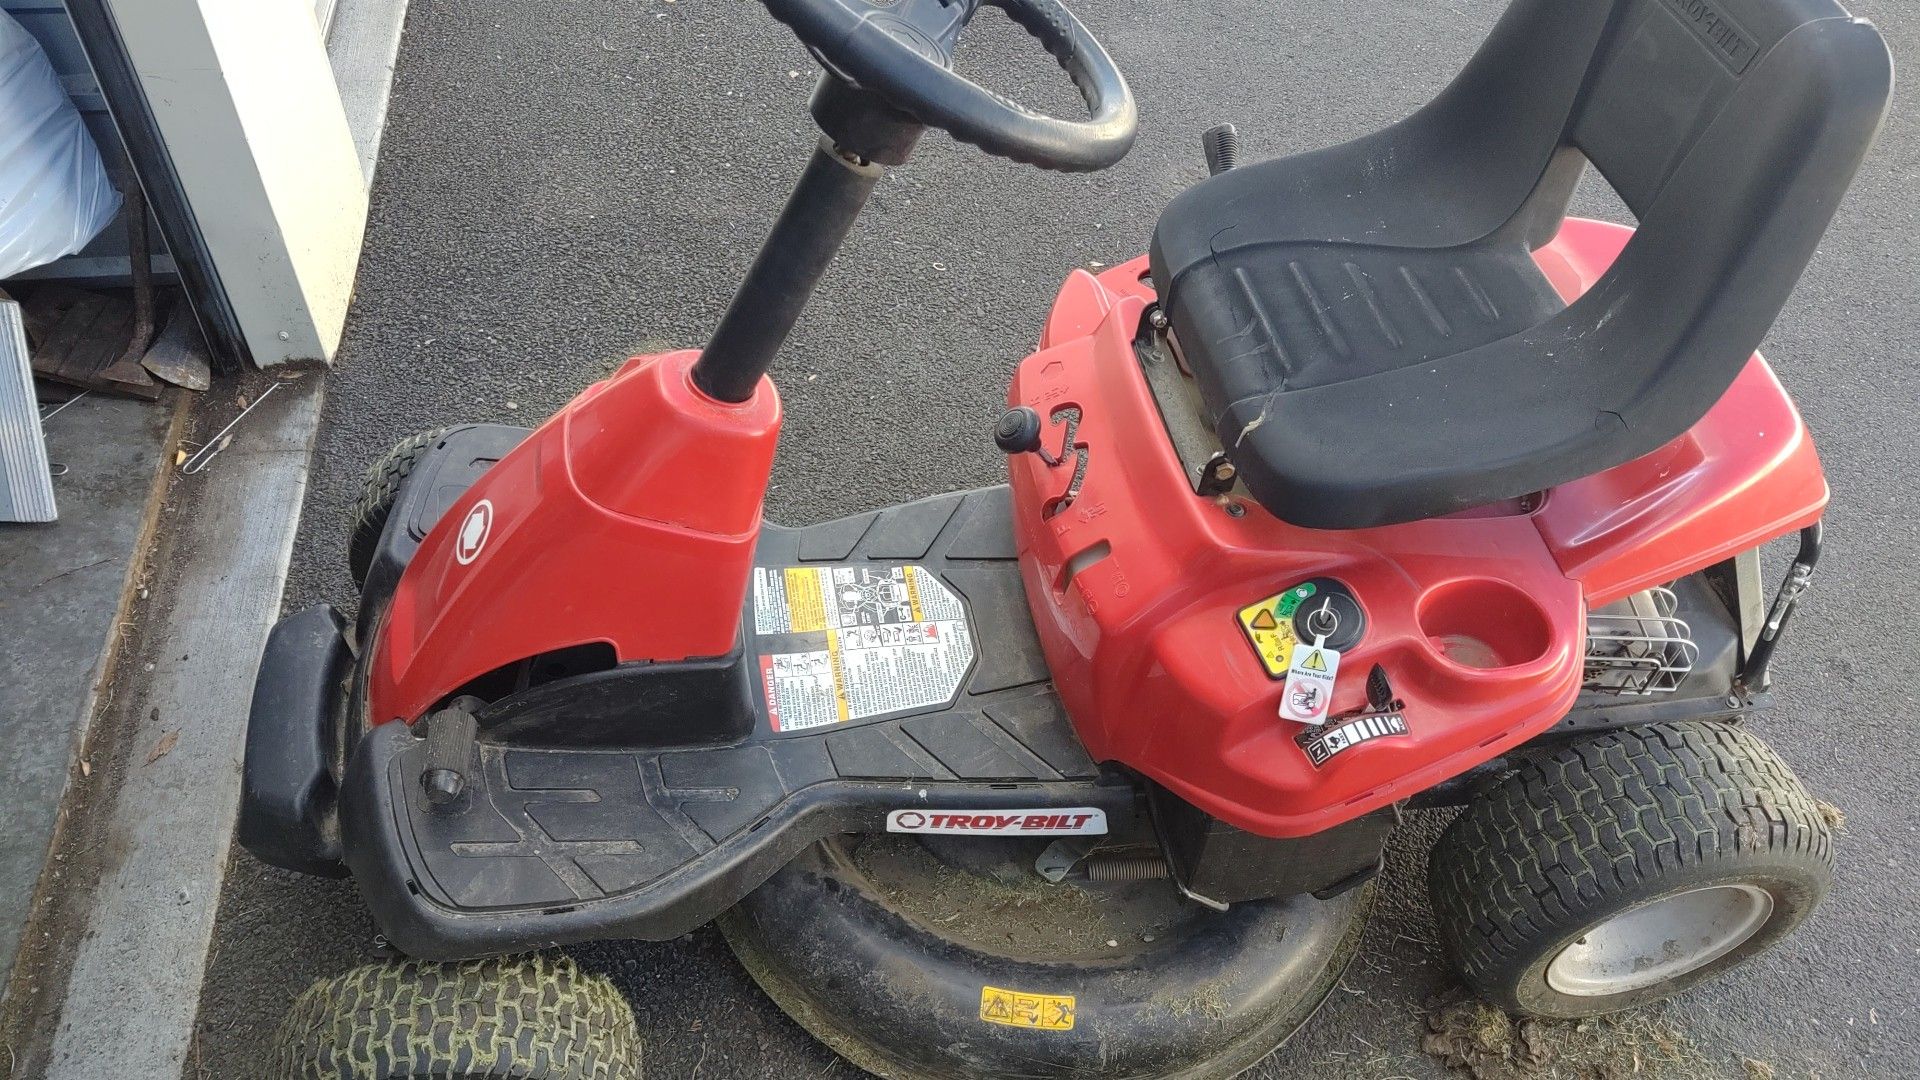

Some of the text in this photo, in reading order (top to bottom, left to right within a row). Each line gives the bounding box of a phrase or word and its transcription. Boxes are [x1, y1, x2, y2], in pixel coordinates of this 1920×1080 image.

[906, 573, 919, 606] WARNING
[765, 667, 777, 706] DANGER
[831, 650, 843, 691] WARNING
[929, 814, 1094, 830] TROY-BILT
